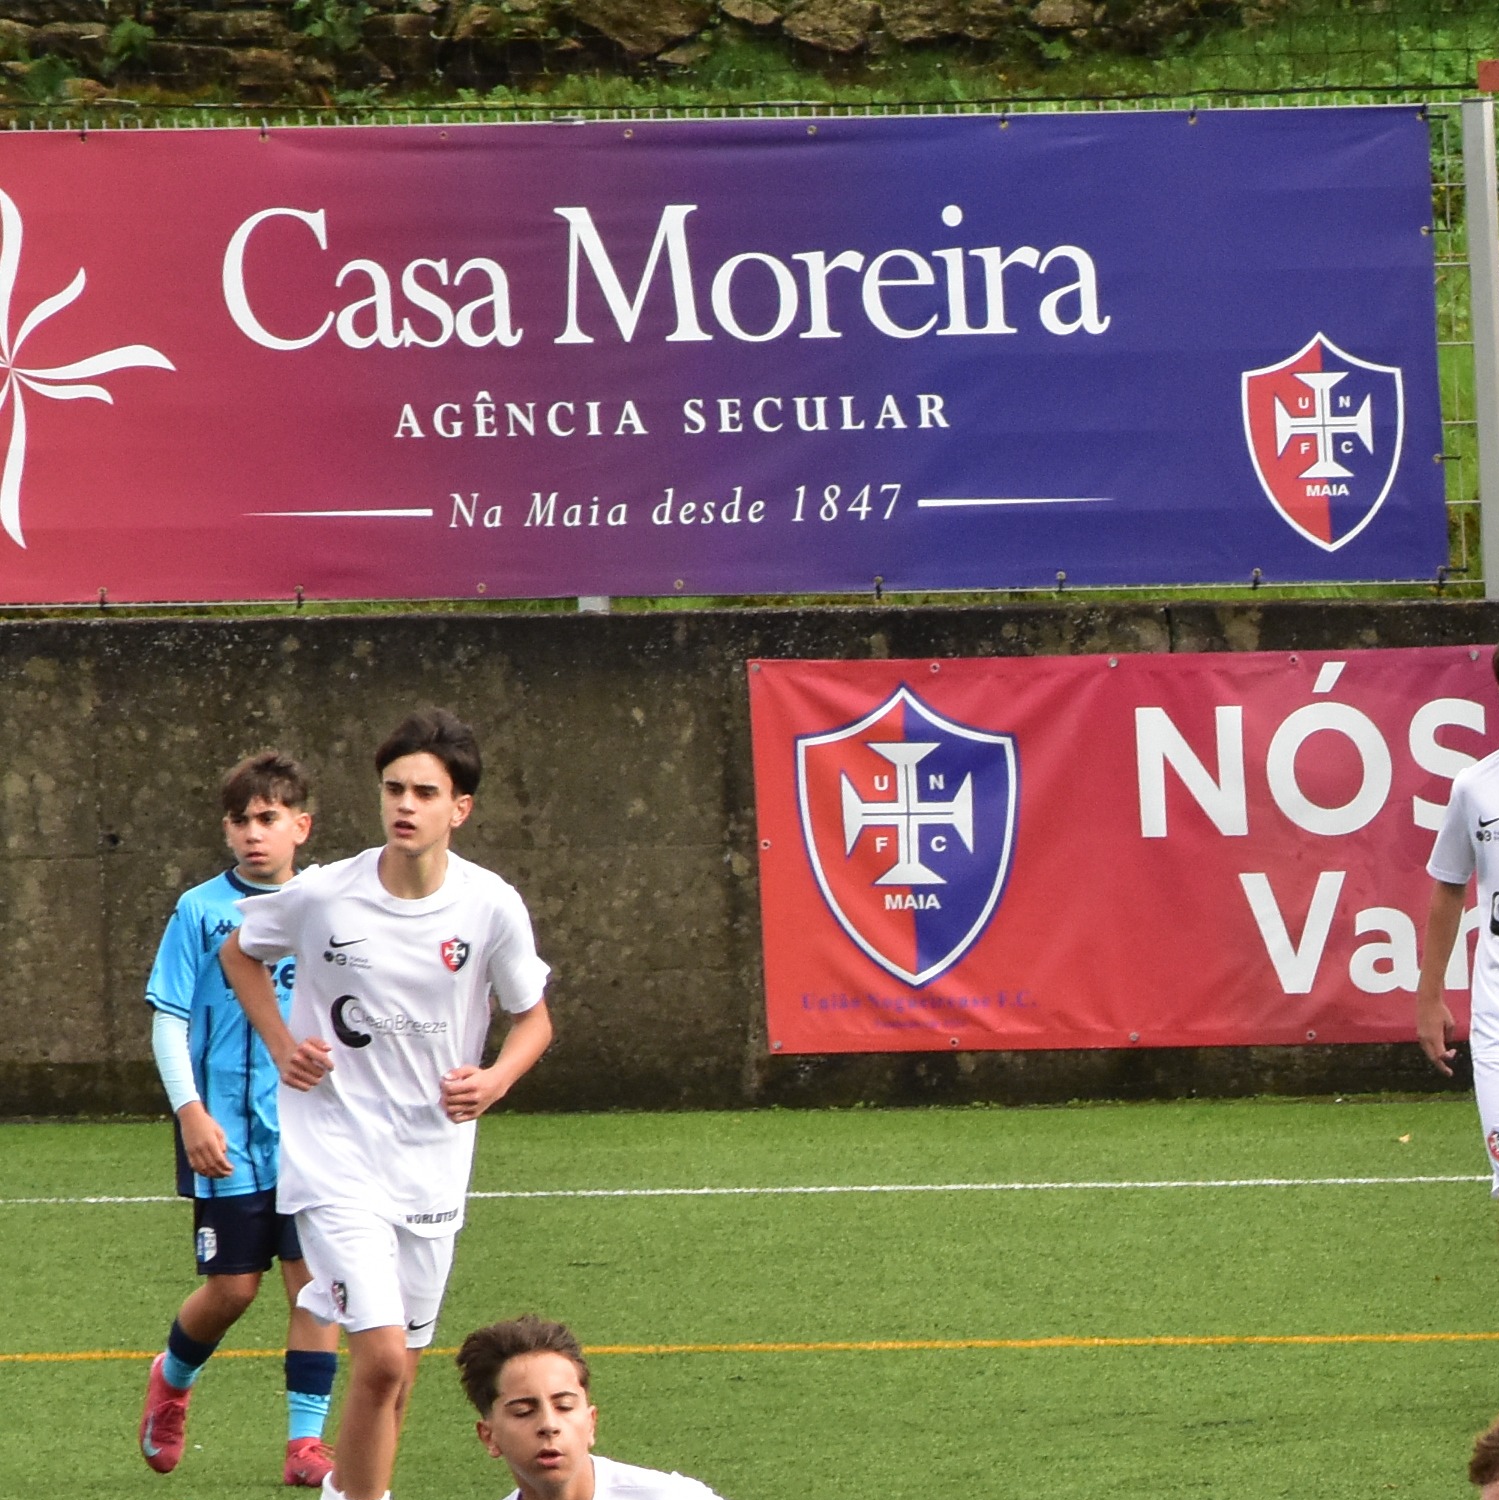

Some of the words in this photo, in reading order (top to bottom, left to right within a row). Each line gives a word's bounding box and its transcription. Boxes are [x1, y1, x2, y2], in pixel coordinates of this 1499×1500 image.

[223, 208, 523, 350] Casa
[554, 205, 1110, 344] Moreira
[1297, 396, 1310, 410] U
[1338, 395, 1351, 409] N
[394, 391, 648, 438] AGÊNCIA
[684, 395, 950, 433] SECULAR
[1300, 442, 1311, 455] F
[1340, 440, 1354, 454] C
[1305, 484, 1350, 497] MAIA
[450, 493, 502, 528] Na
[524, 491, 627, 527] Maia
[652, 486, 765, 526] desde
[792, 484, 902, 522] 1847
[1135, 662, 1486, 838] NÓS
[873, 775, 889, 791] U
[928, 774, 945, 791] N
[875, 836, 889, 853] F
[930, 835, 947, 853] C
[884, 893, 942, 910] MAIA
